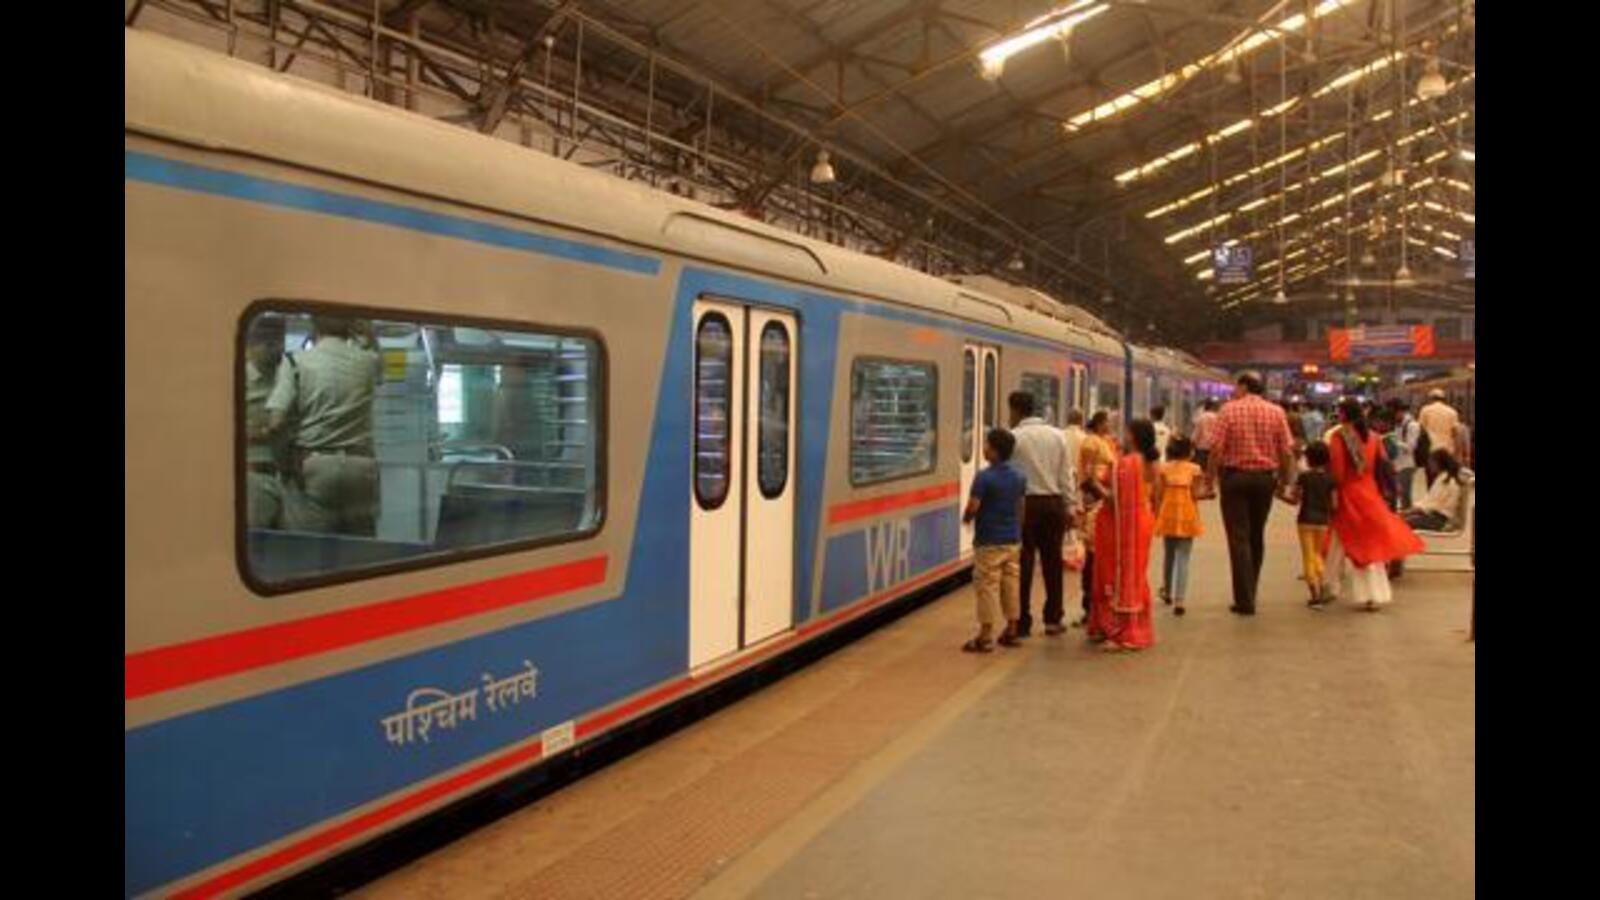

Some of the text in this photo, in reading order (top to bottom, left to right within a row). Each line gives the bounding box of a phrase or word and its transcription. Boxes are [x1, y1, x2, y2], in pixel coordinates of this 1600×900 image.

[865, 518, 912, 594] WR
[381, 686, 479, 745] पश्चिम
[481, 659, 539, 711] रेलवे
